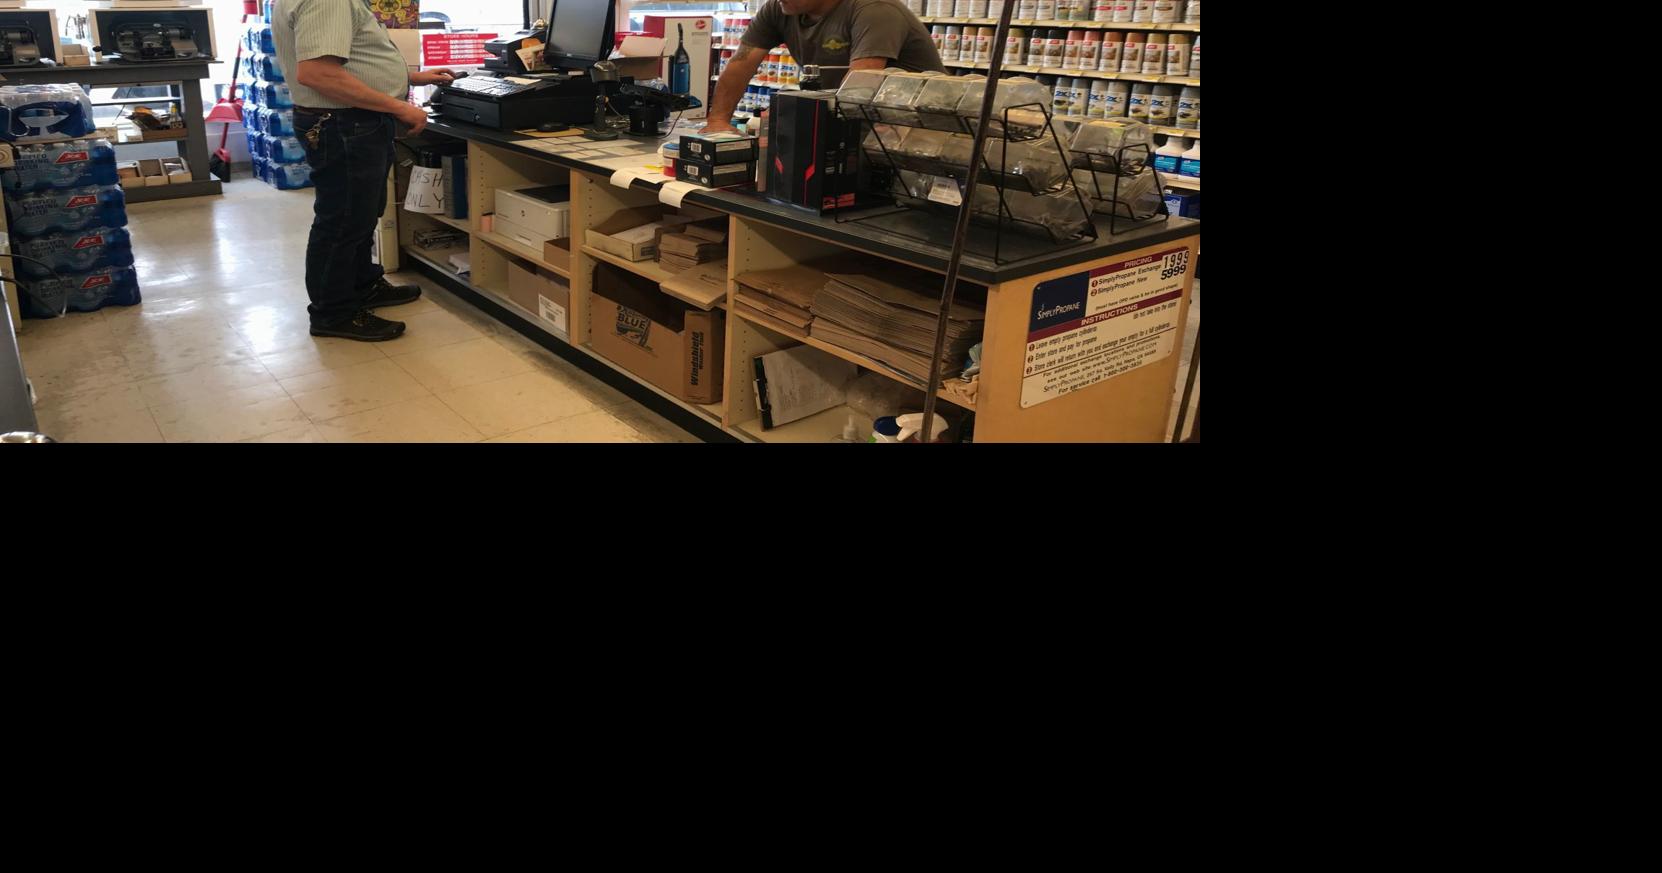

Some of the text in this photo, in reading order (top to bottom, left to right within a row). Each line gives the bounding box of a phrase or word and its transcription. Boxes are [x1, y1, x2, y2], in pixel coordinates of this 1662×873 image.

[1124, 256, 1153, 269] PRICING
[1163, 250, 1190, 269] 1999
[1098, 271, 1136, 286] SimplyPropane
[1138, 264, 1162, 276] Exchange
[1160, 264, 1187, 281] 5999
[1097, 279, 1135, 295] SimplyPropane
[1037, 301, 1081, 320] SIMPLYPROPANE
[1081, 303, 1138, 326] INSTRUCTIONS
[618, 313, 647, 330] BLUE
[690, 331, 699, 386] Windshield
